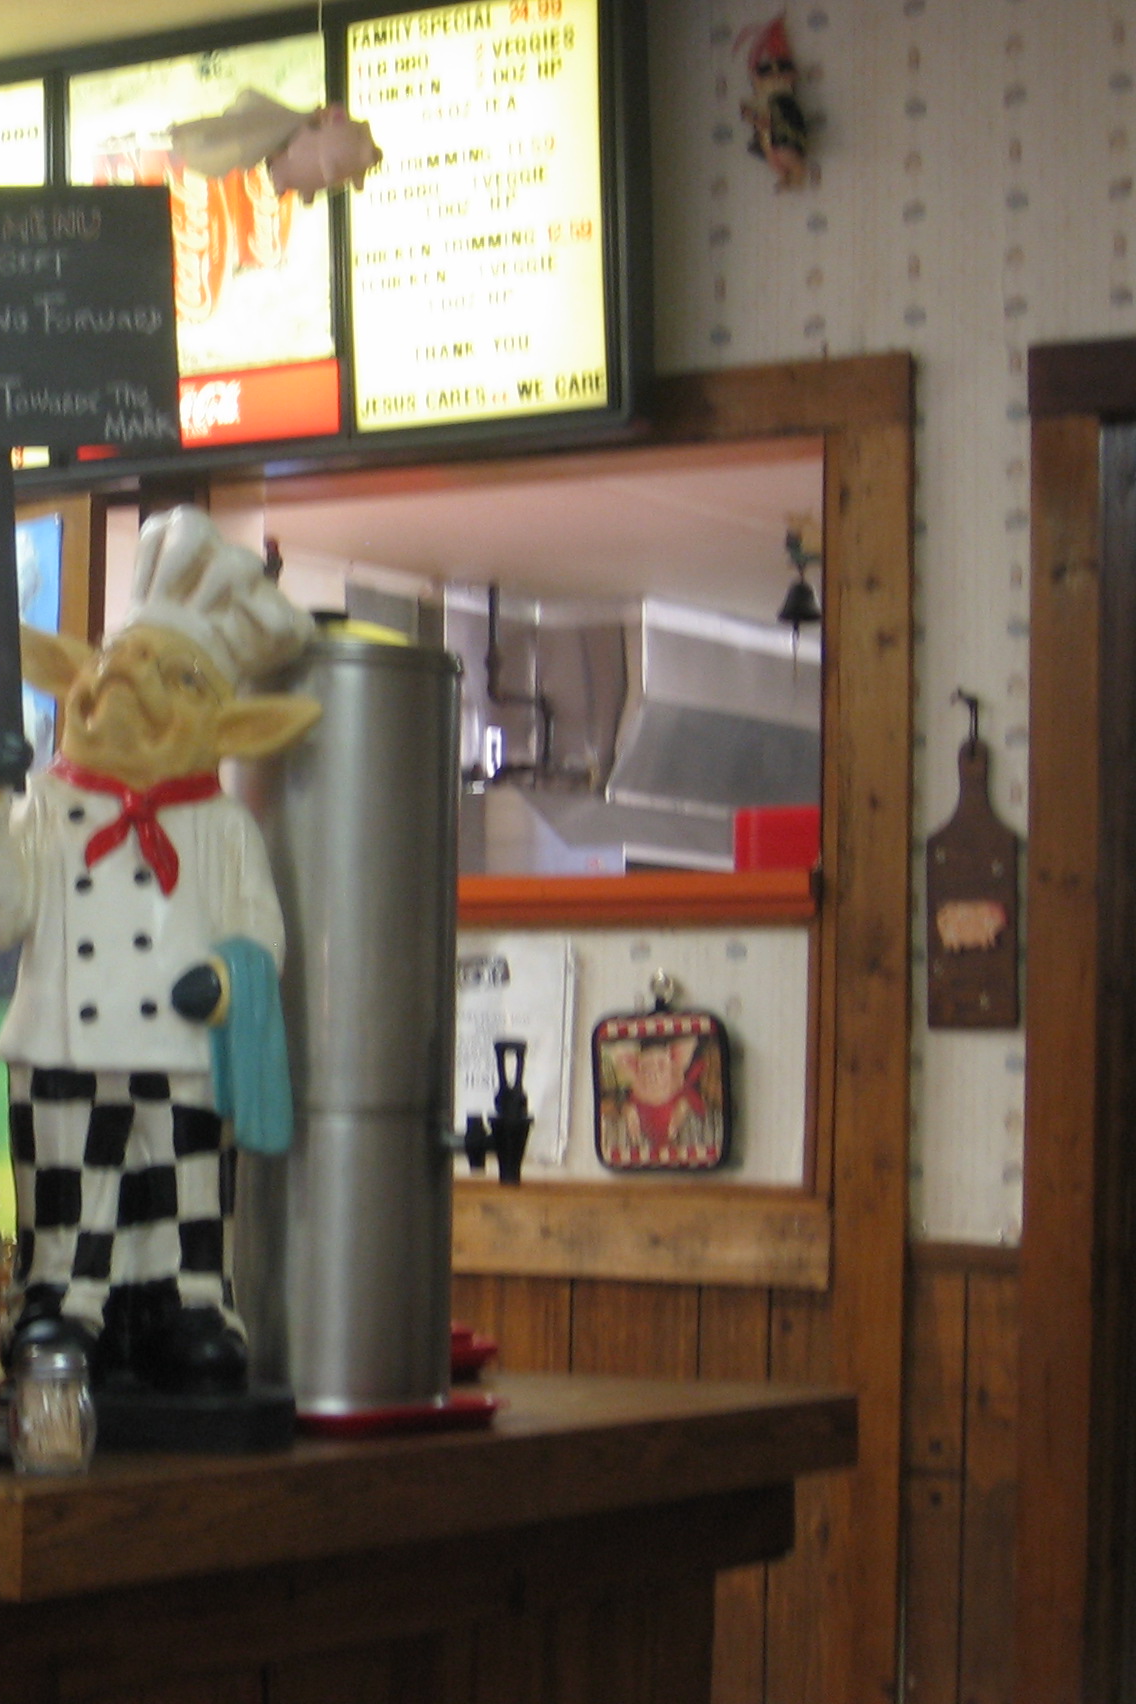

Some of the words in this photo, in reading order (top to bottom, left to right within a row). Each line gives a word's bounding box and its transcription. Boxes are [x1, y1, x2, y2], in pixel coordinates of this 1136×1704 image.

[352, 19, 413, 50] FAMILY
[418, 8, 493, 37] SPECIAL
[414, 341, 475, 363] THANK
[493, 334, 532, 354] YOU
